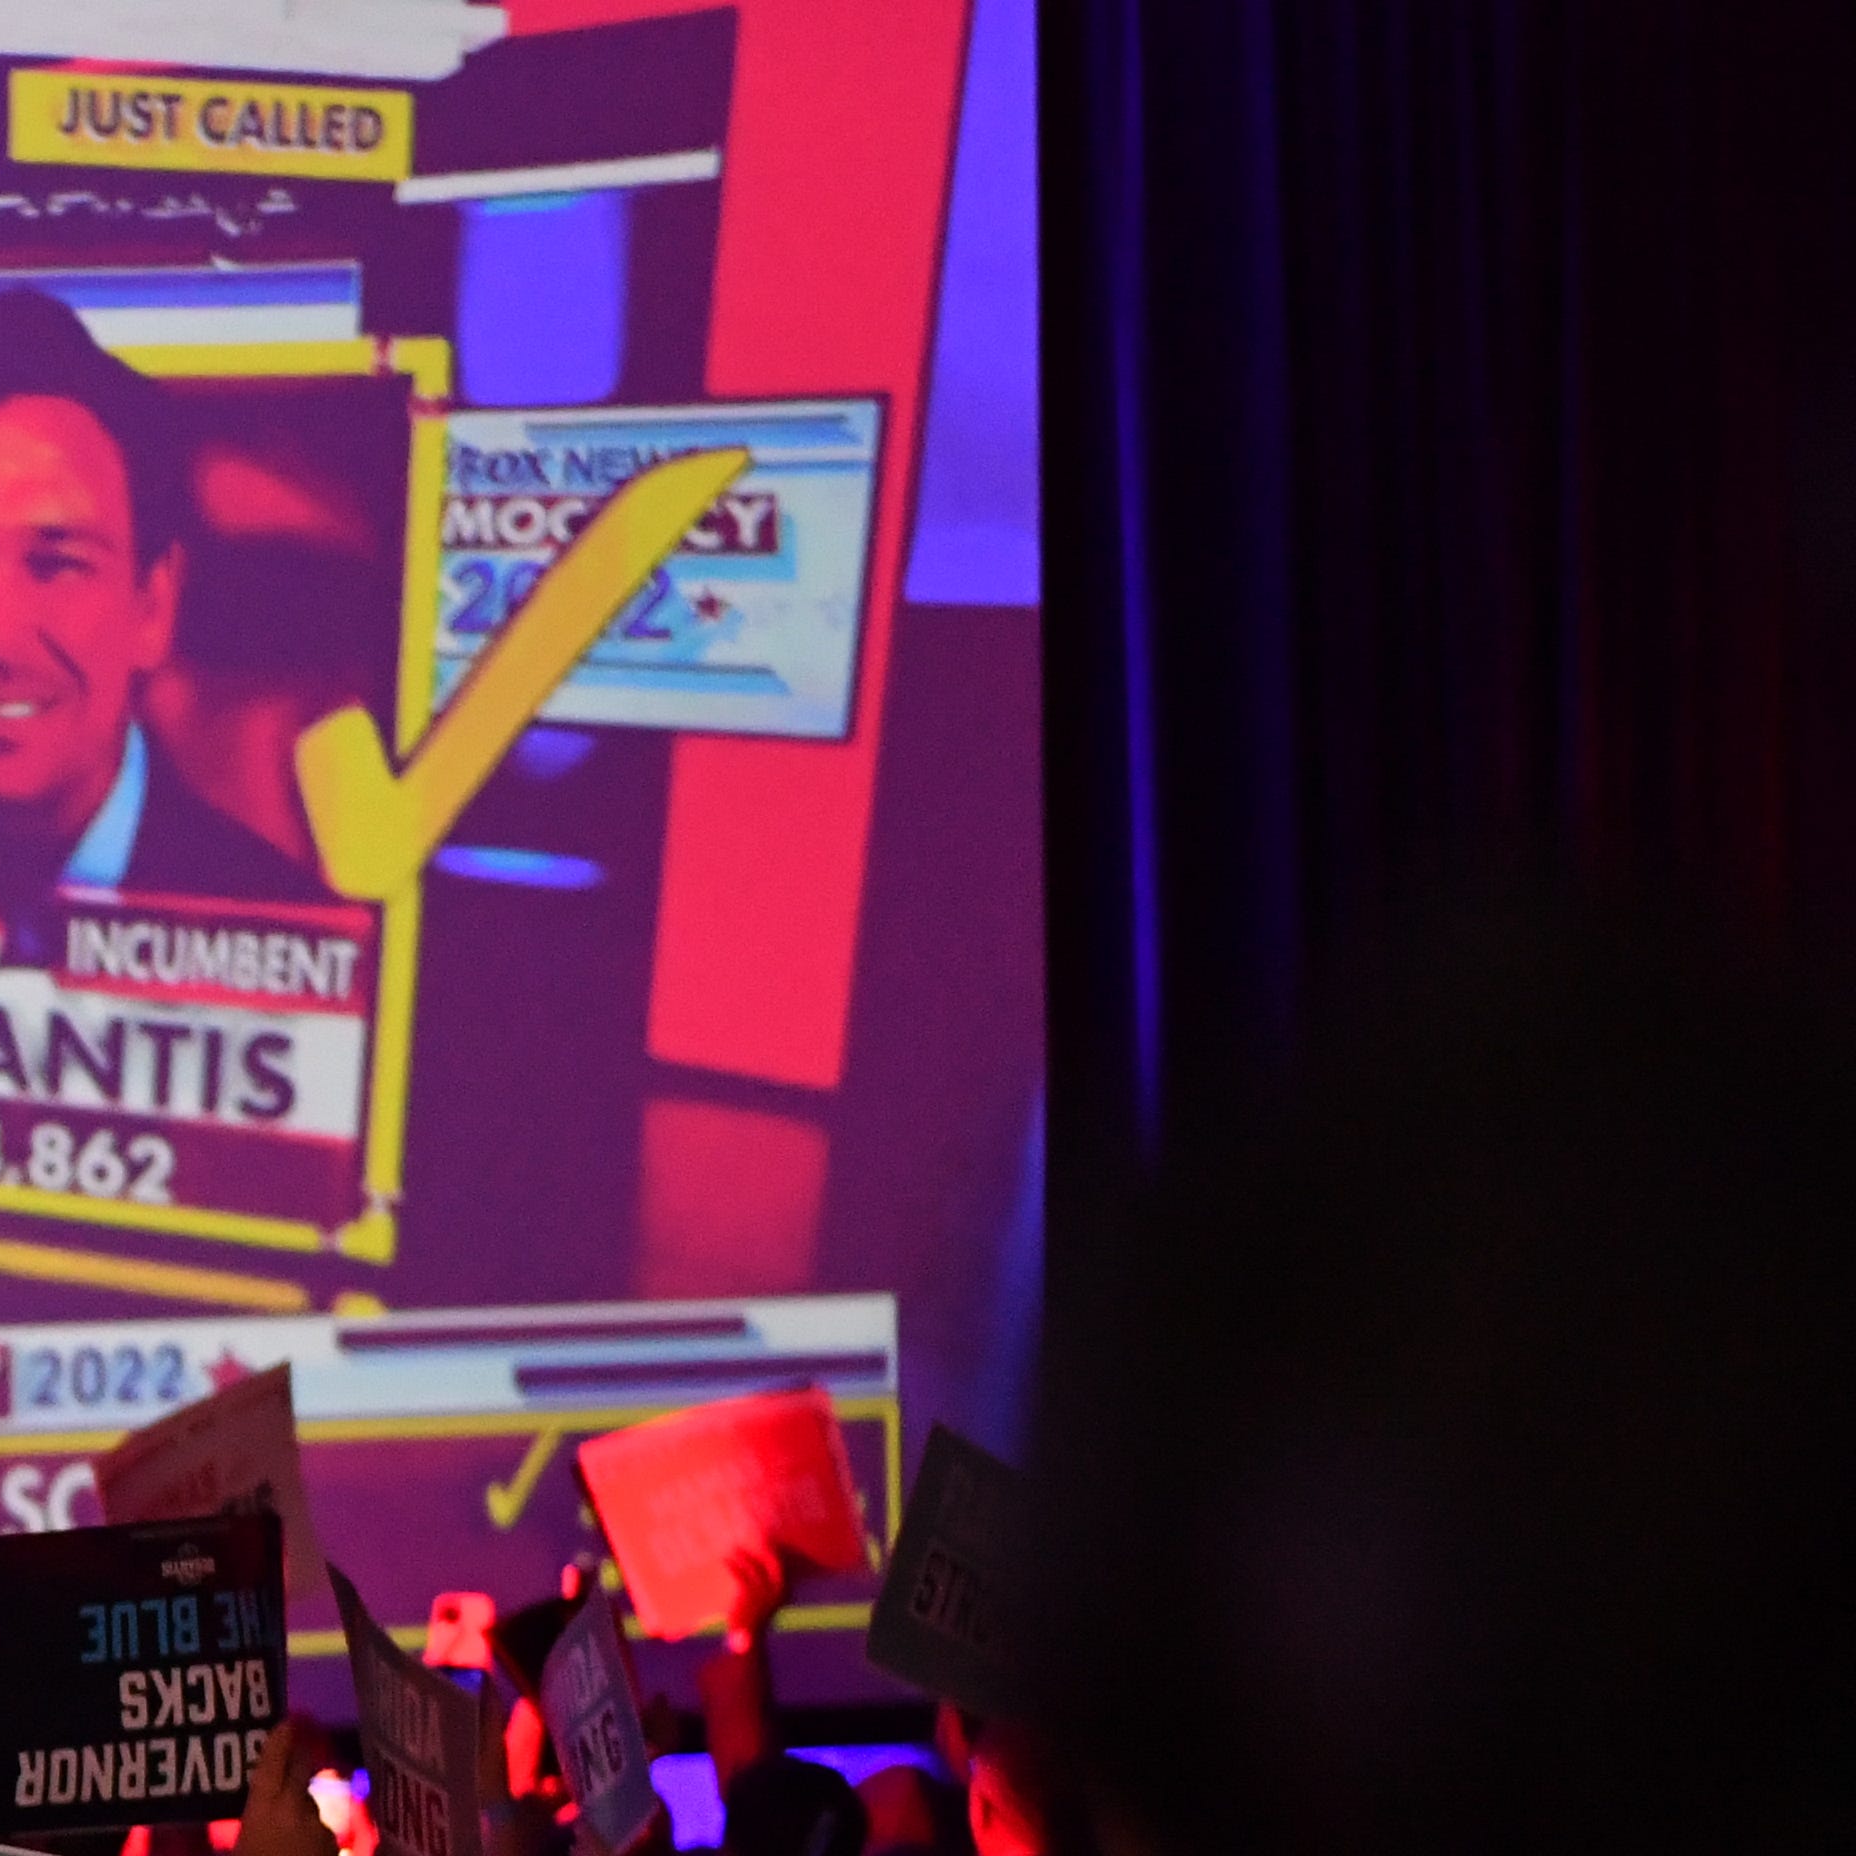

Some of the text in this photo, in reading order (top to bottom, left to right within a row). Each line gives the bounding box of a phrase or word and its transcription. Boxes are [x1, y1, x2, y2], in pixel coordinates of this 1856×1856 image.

[56, 86, 385, 153] JUST CALLED
[67, 918, 360, 998] INCUMBENT
[25, 1344, 187, 1411] 2022
[78, 1591, 202, 1664] BLUE
[117, 1658, 273, 1732] BACKS
